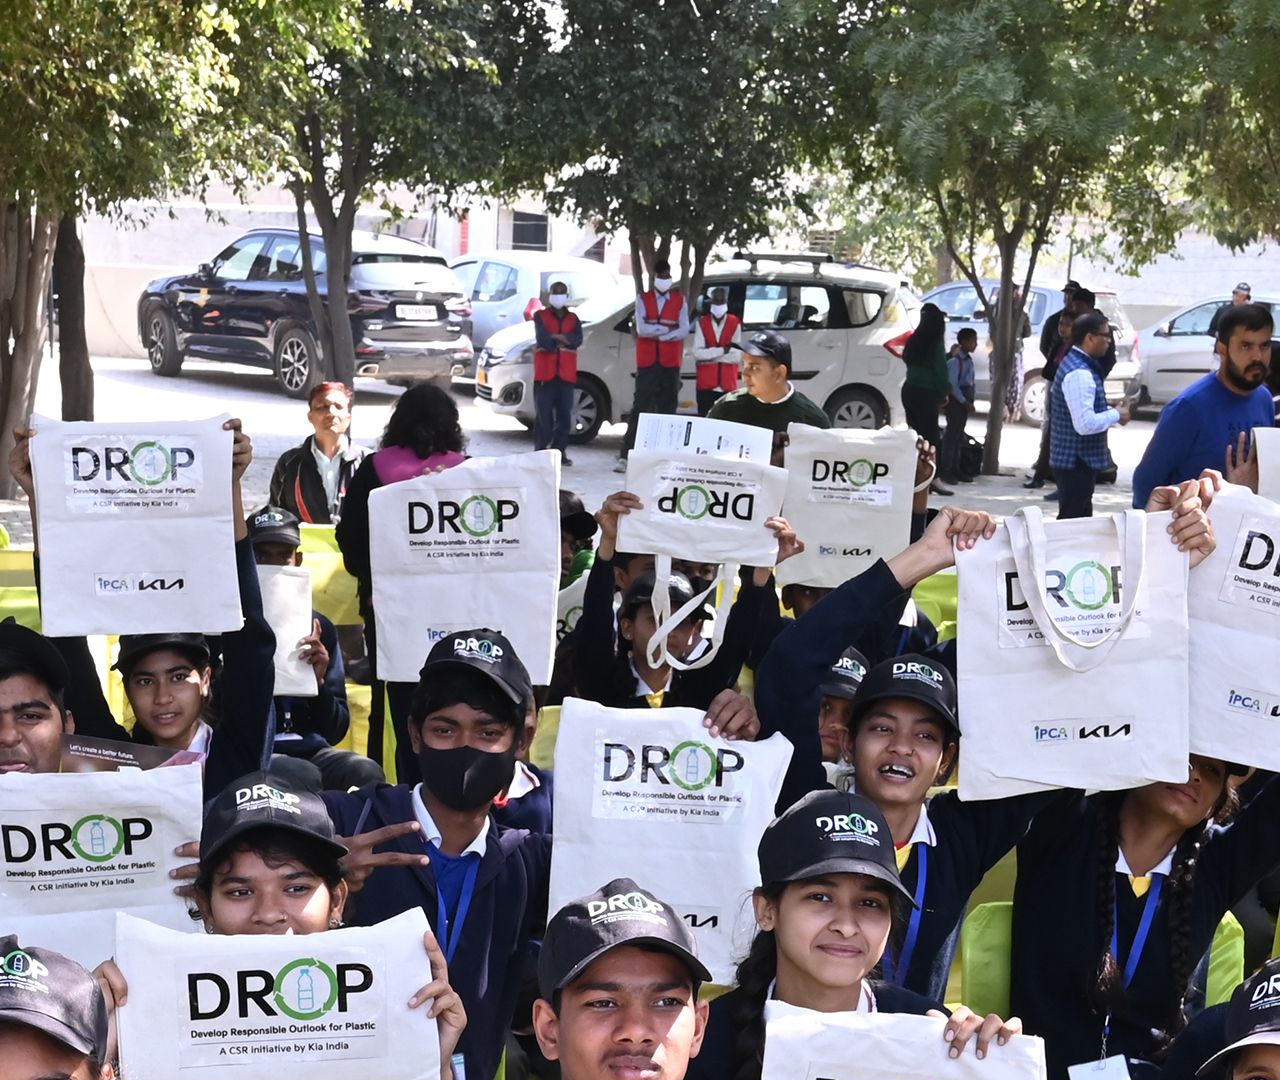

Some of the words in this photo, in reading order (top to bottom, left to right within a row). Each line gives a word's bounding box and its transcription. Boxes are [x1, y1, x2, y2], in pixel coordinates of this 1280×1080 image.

[72, 441, 195, 486] DROP
[811, 458, 890, 487] DROP
[408, 494, 520, 537] DROP
[453, 638, 504, 657] DROP
[892, 662, 943, 681] DROP
[603, 740, 745, 791] DROP
[235, 784, 301, 804] DROP
[1, 814, 153, 863] DROP
[587, 892, 664, 917] DROP
[187, 957, 374, 1021] DROP
[190, 1028, 229, 1039] Develop
[230, 1025, 287, 1038] Responsible
[288, 1023, 327, 1034] Outlook
[328, 1022, 343, 1032] for
[345, 1021, 376, 1031] Plastic
[219, 1047, 227, 1056] A
[228, 1045, 249, 1055] CSR
[250, 1044, 292, 1054] initiative
[293, 1043, 306, 1054] by
[307, 1042, 324, 1052] Kia
[325, 1041, 350, 1051] India
